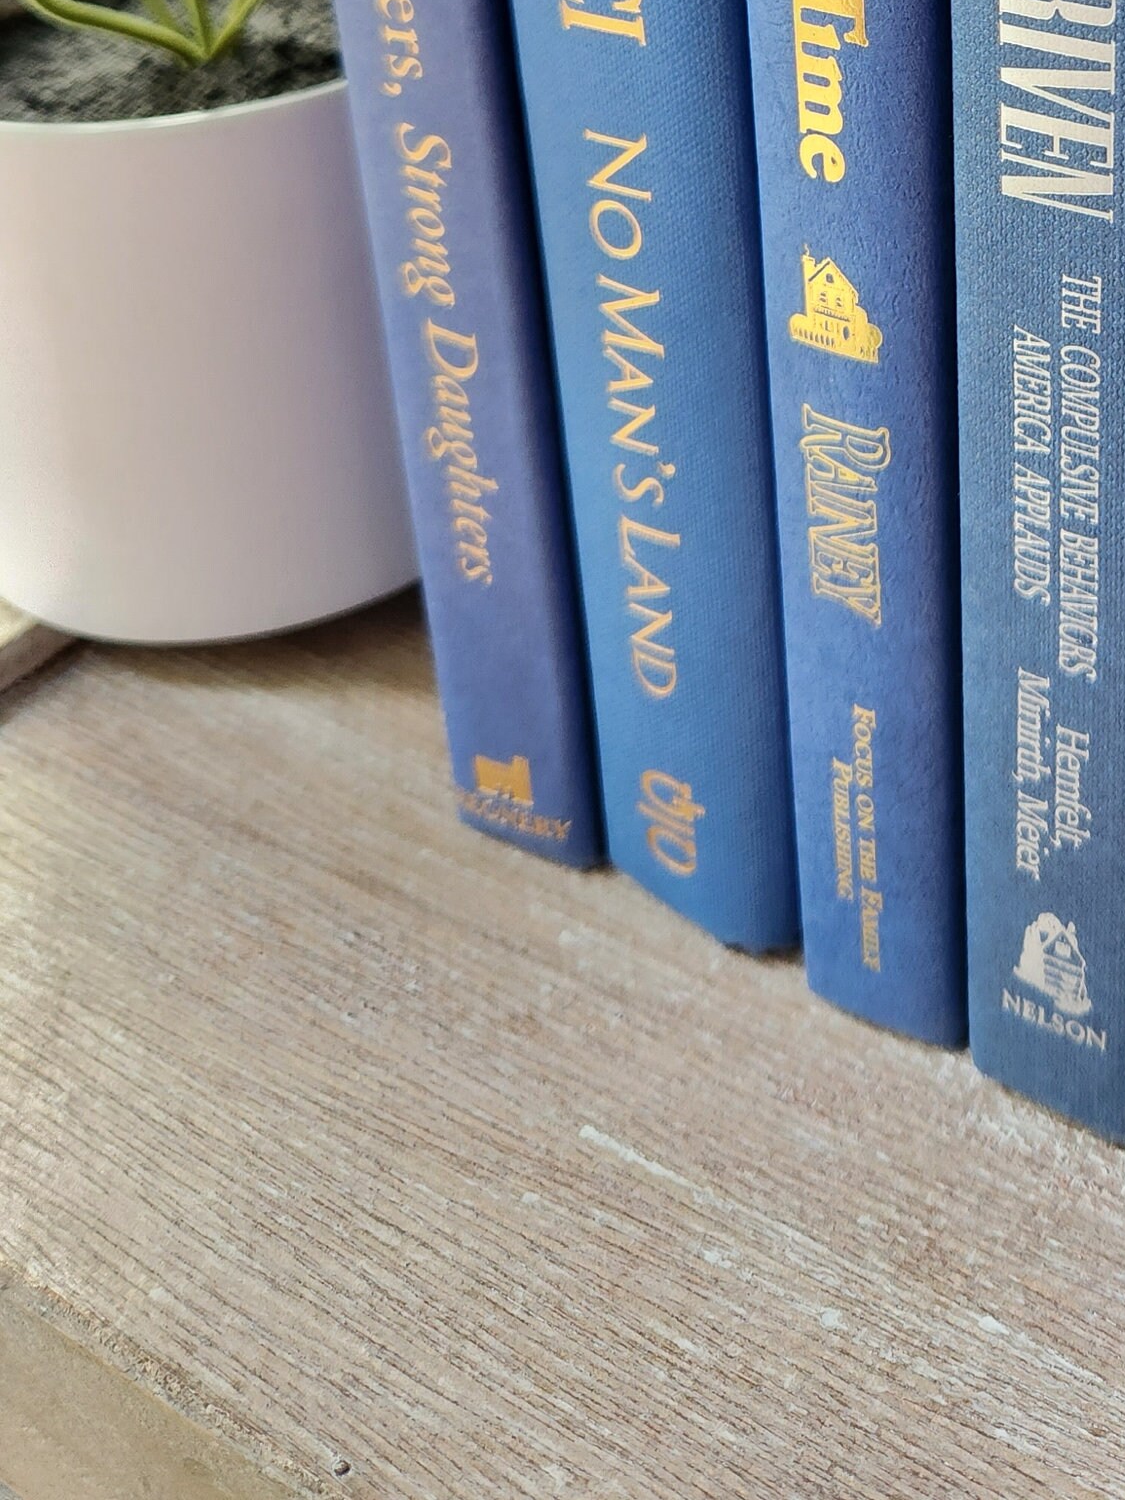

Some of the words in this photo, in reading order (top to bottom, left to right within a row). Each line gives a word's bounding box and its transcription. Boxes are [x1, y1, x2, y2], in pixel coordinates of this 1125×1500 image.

[397, 123, 455, 309] Strong
[585, 128, 651, 259] NO
[1061, 273, 1102, 334] THE
[425, 318, 499, 587] Daughters
[598, 274, 676, 506] MAN'S
[1013, 324, 1052, 454] AMERICA
[1060, 344, 1101, 525] COMPULSIVE
[801, 403, 891, 627] RAINEY
[1013, 462, 1052, 606] APPLAUDS
[619, 515, 680, 698] LAND
[1058, 528, 1099, 683] BEHAVIORS
[853, 704, 876, 787] FOCUS
[1013, 666, 1051, 785] Minirth,
[1056, 723, 1091, 851] Hemfelt,
[831, 757, 853, 901] PUBLISHING
[856, 794, 875, 832] ON
[858, 837, 877, 883] THE
[1016, 790, 1050, 881] Meier
[1002, 988, 1107, 1051] NELSON
